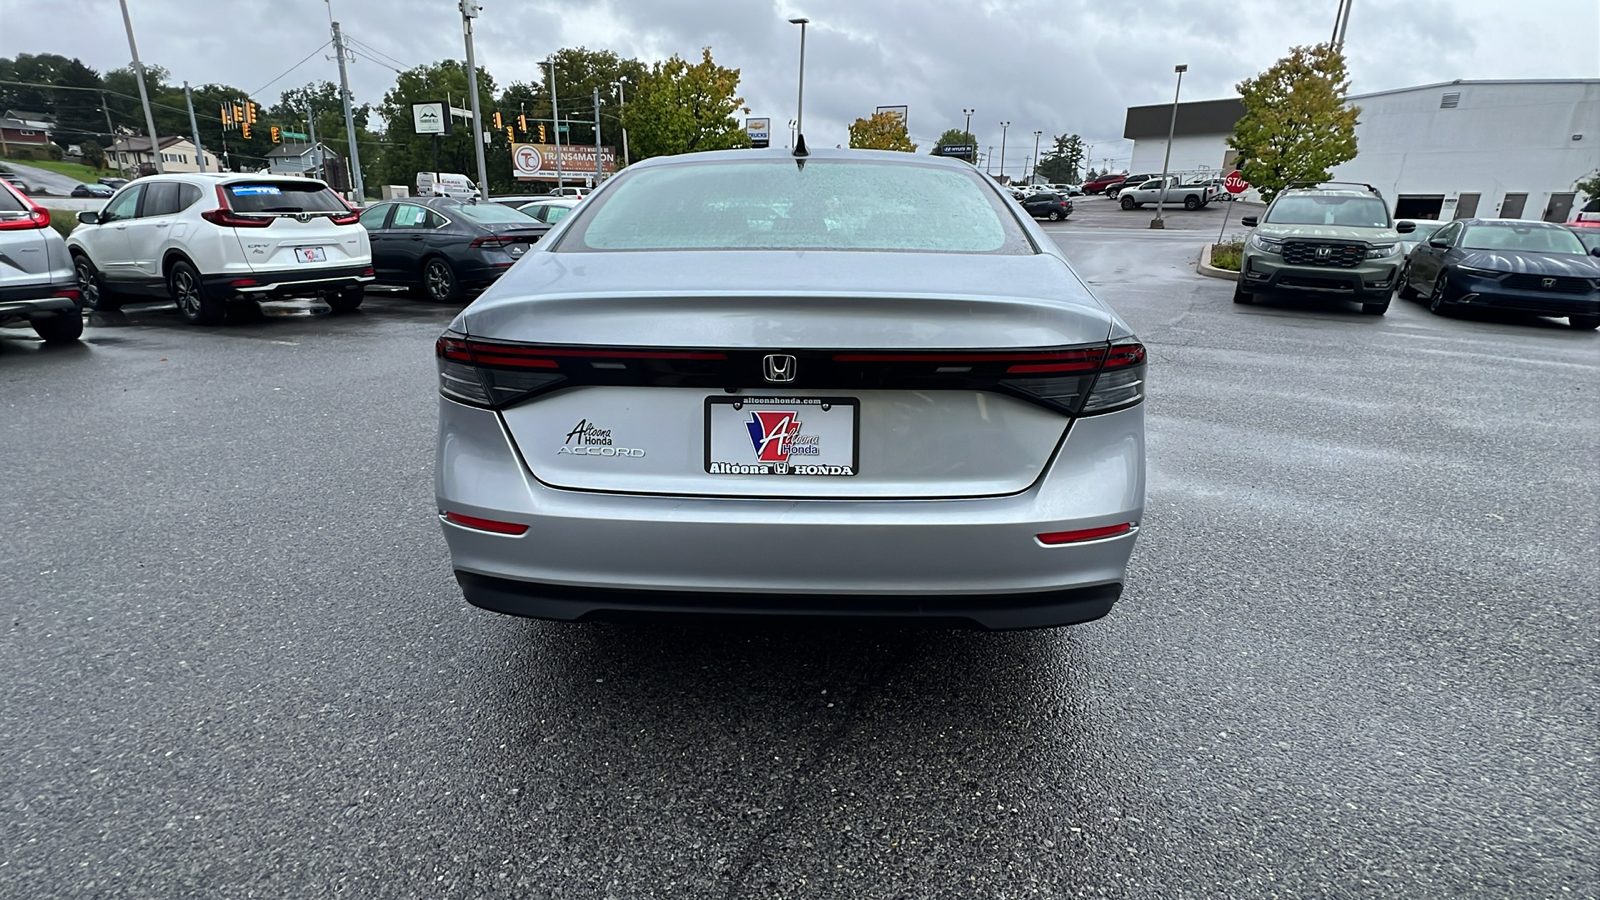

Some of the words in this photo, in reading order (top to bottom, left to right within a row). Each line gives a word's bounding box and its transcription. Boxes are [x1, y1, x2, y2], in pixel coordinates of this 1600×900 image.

[543, 152, 614, 162] TRANS4MATON
[565, 418, 612, 445] Altoona
[758, 416, 819, 455] Altoona
[585, 436, 612, 446] Honda
[557, 445, 646, 458] ACCORD
[783, 445, 818, 455] Honda
[710, 462, 769, 474] Altoona
[795, 465, 854, 476] HONDA
